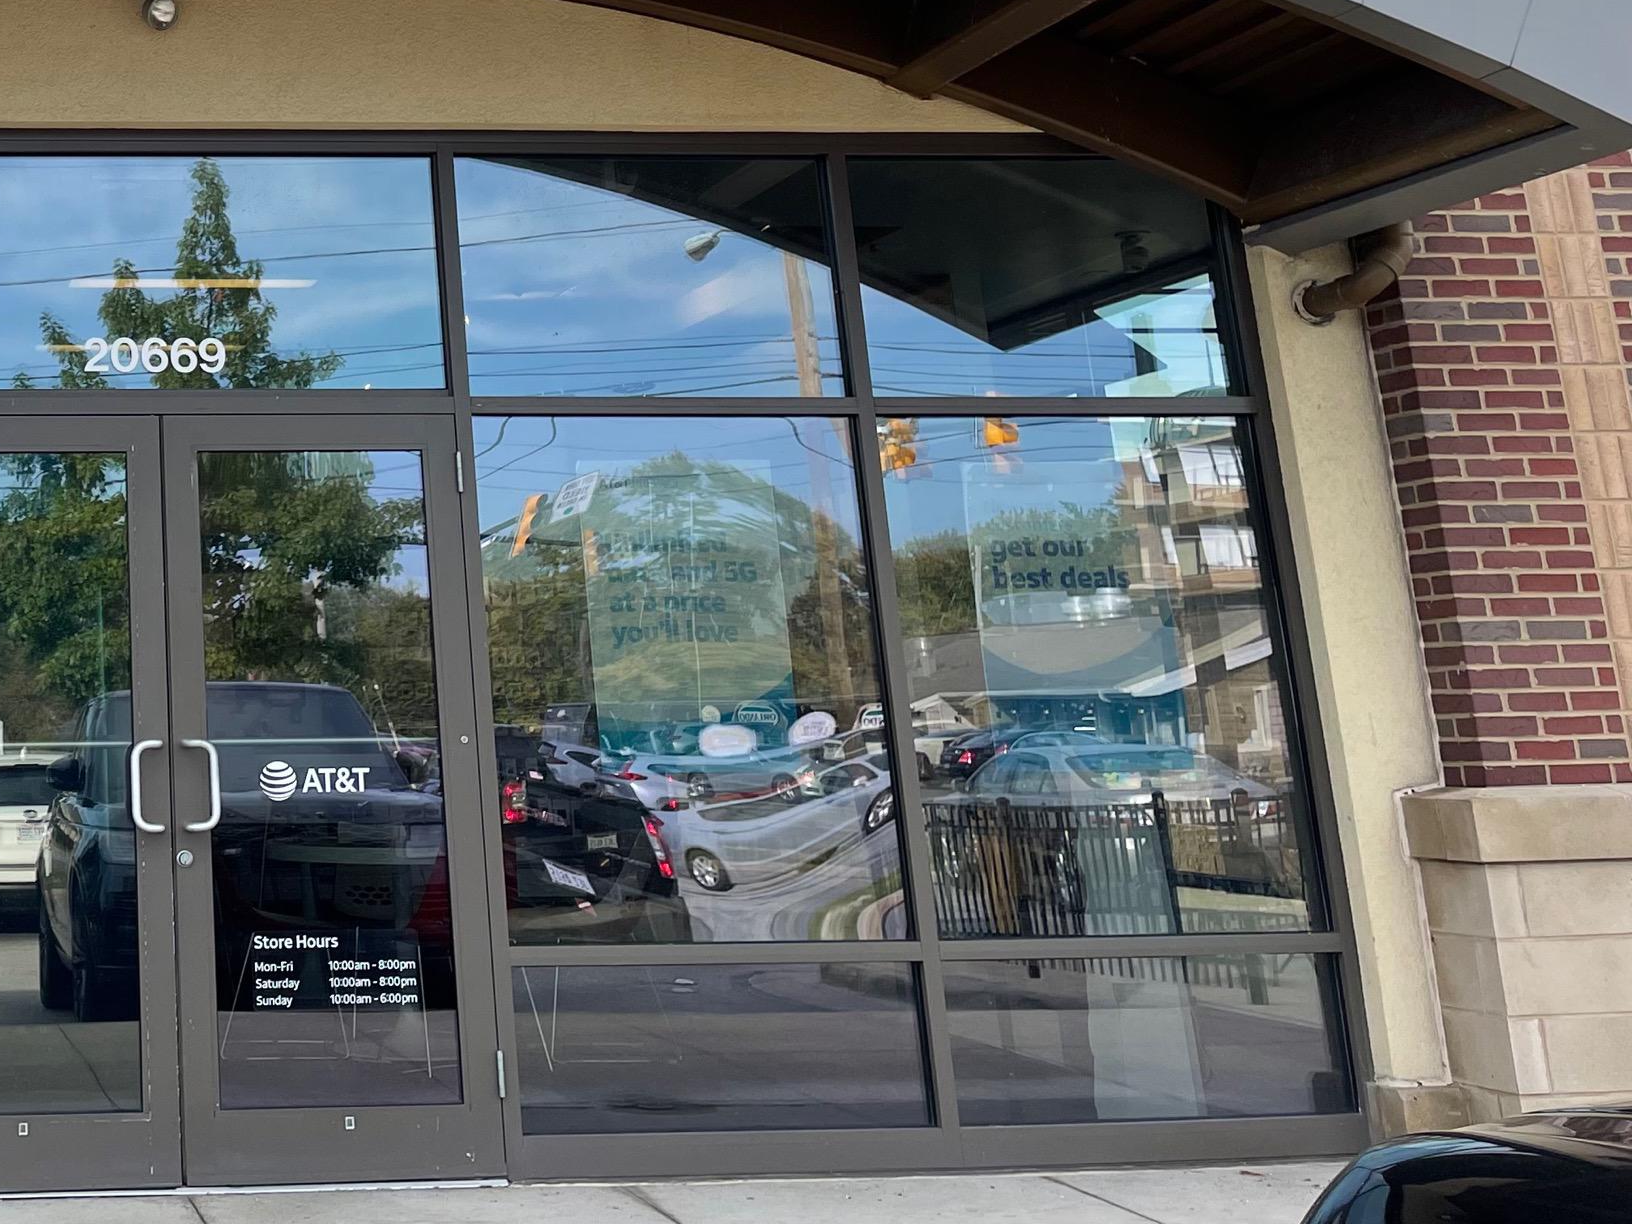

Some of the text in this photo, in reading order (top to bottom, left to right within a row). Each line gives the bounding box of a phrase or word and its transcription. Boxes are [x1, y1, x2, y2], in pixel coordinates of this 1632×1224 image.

[83, 337, 227, 374] 20669
[991, 537, 1088, 563] get our
[992, 564, 1131, 589] best deals
[301, 766, 370, 793] AT&T
[253, 934, 339, 949] Store Hours
[254, 961, 294, 972] Mon-Fri
[327, 960, 370, 971] 10:00am
[377, 959, 416, 972] 8:00pm
[255, 977, 300, 991] Saturday
[328, 977, 371, 988] 10:00am
[379, 976, 417, 989] 8:00pm
[256, 995, 294, 1008] Sunday
[329, 994, 372, 1005] 10:00am
[380, 993, 418, 1006] 6:00pm
